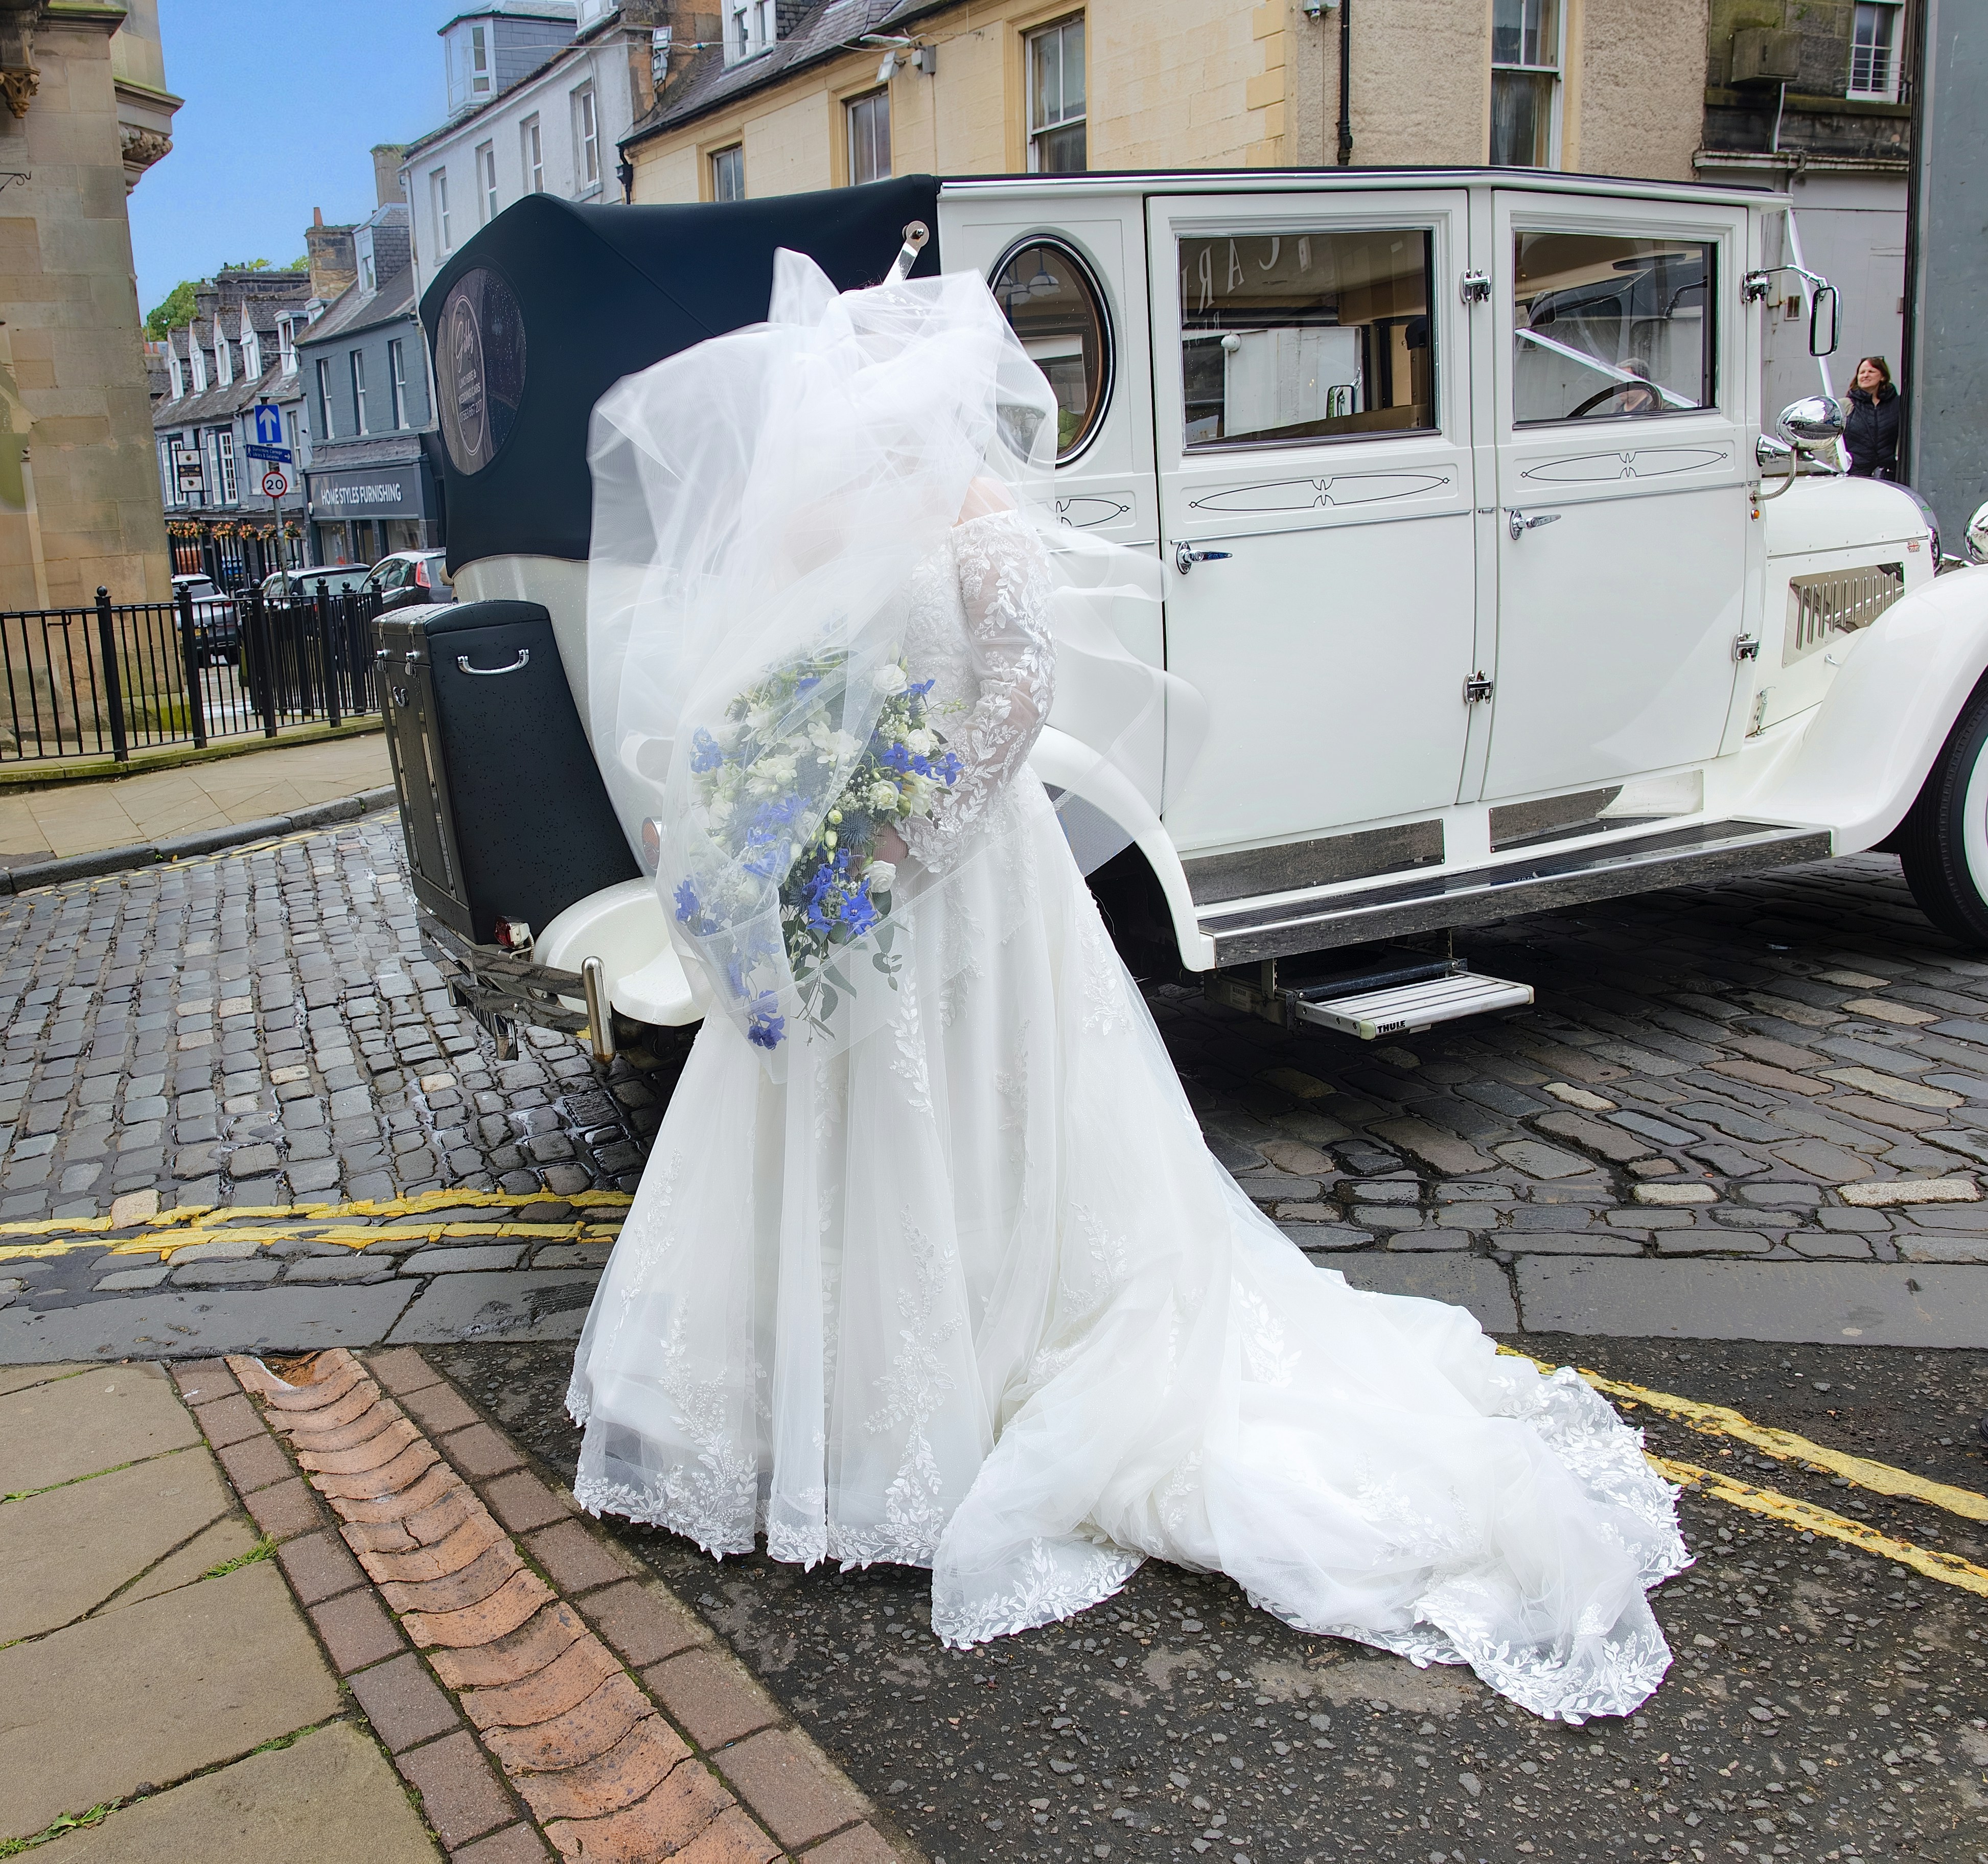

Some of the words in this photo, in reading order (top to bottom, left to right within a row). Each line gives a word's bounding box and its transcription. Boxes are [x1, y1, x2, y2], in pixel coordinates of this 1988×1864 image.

[455, 319, 474, 373] Gibbs
[473, 368, 477, 379] &
[471, 382, 481, 397] CARS
[266, 479, 284, 490] 20
[359, 483, 402, 504] FURNISHING
[1377, 1020, 1405, 1033] THULE
